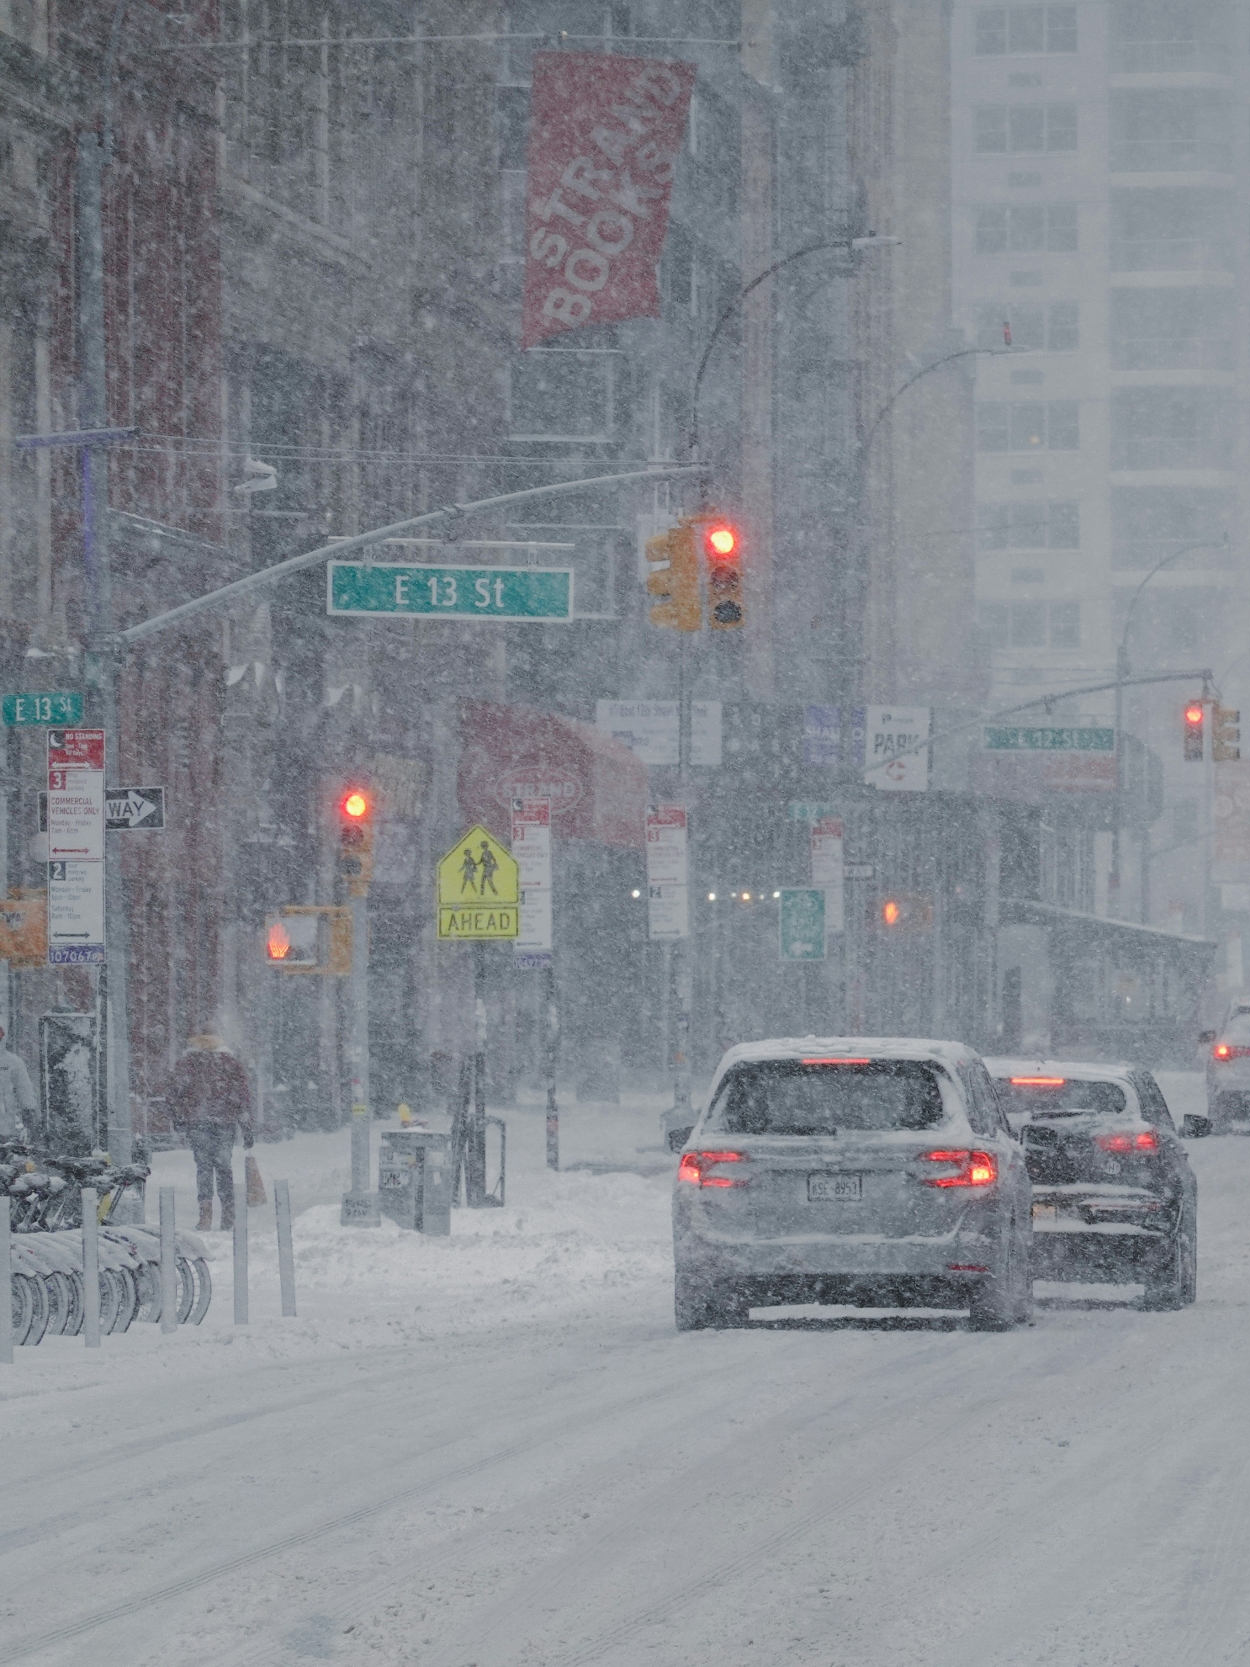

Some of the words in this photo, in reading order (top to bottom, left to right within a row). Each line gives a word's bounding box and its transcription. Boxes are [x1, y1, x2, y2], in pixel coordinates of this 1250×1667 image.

[530, 65, 681, 268] STRAND
[541, 140, 673, 328] BOOKS
[395, 575, 410, 605] E
[427, 576, 457, 607] 13
[474, 577, 506, 608] St
[15, 698, 26, 721] E
[35, 697, 52, 720] 13
[60, 696, 72, 712] St
[65, 733, 74, 741] NO
[75, 733, 103, 741] STANDING
[53, 771, 62, 789] 3
[502, 781, 576, 798] STRAND
[51, 797, 92, 805] COMMERCIAL
[108, 801, 144, 818] WAY
[51, 807, 82, 815] VEHICLES
[83, 807, 100, 815] ONLY
[53, 862, 62, 879] 2
[447, 912, 511, 931] AHEAD
